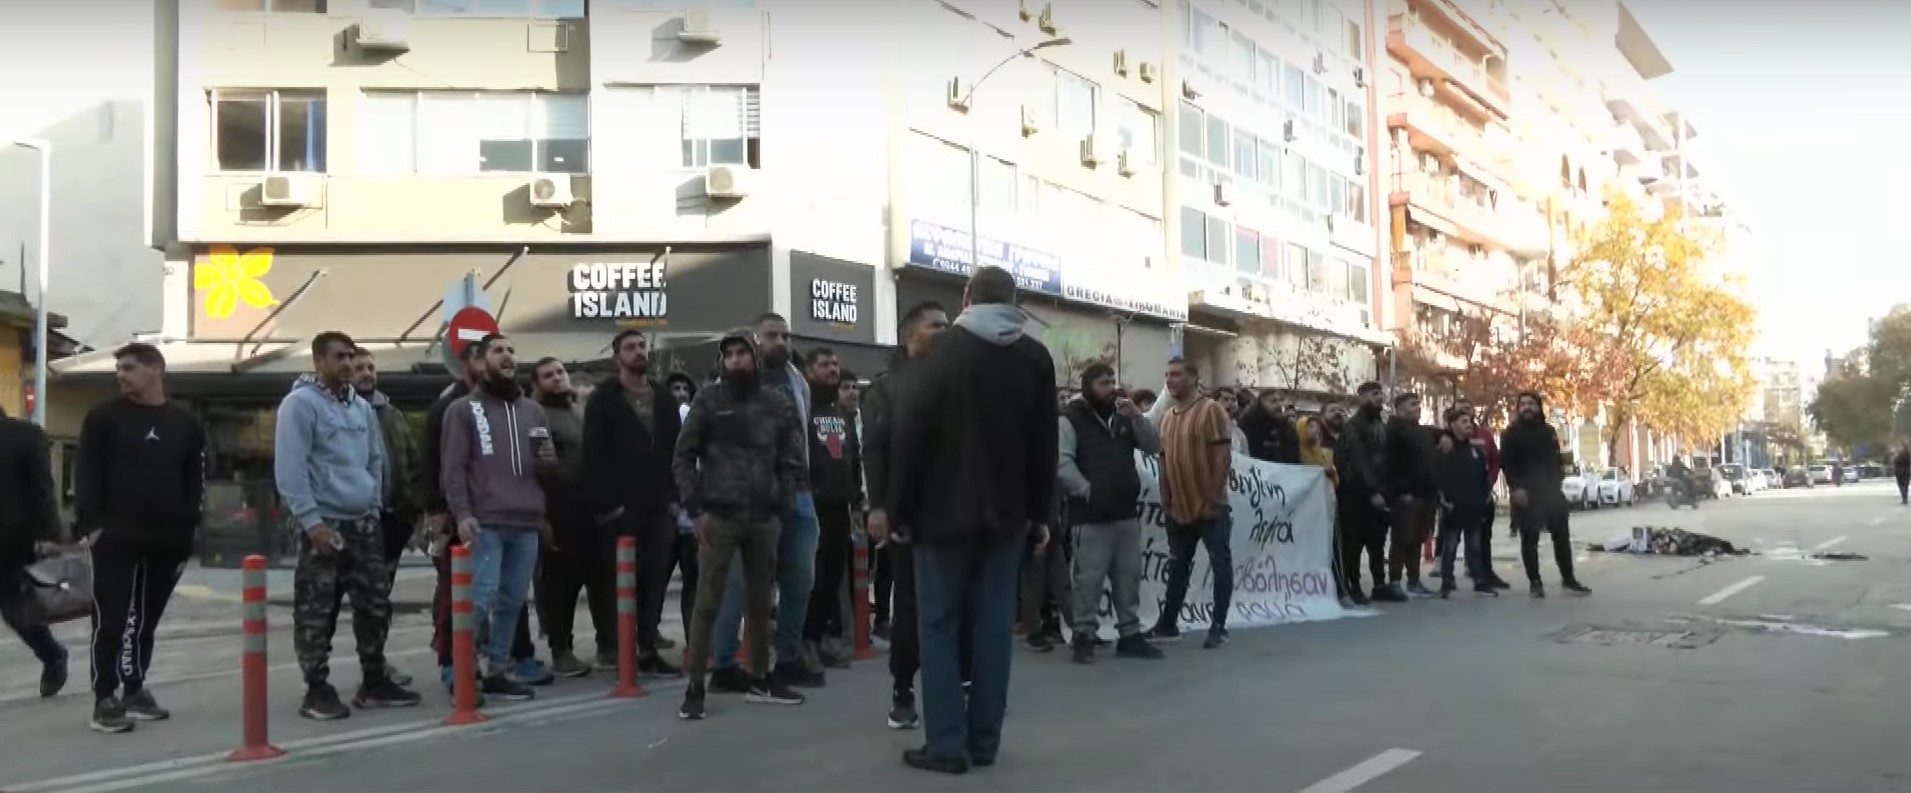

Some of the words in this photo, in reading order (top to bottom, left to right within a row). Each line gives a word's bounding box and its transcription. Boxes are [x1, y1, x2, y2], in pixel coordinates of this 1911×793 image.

[572, 262, 667, 290] COFFEE
[811, 278, 857, 303] COFFEE
[1066, 284, 1113, 305] GRECIA
[573, 291, 667, 318] ISLAND
[812, 298, 857, 323] ISLAND
[468, 400, 494, 456] JORDAN
